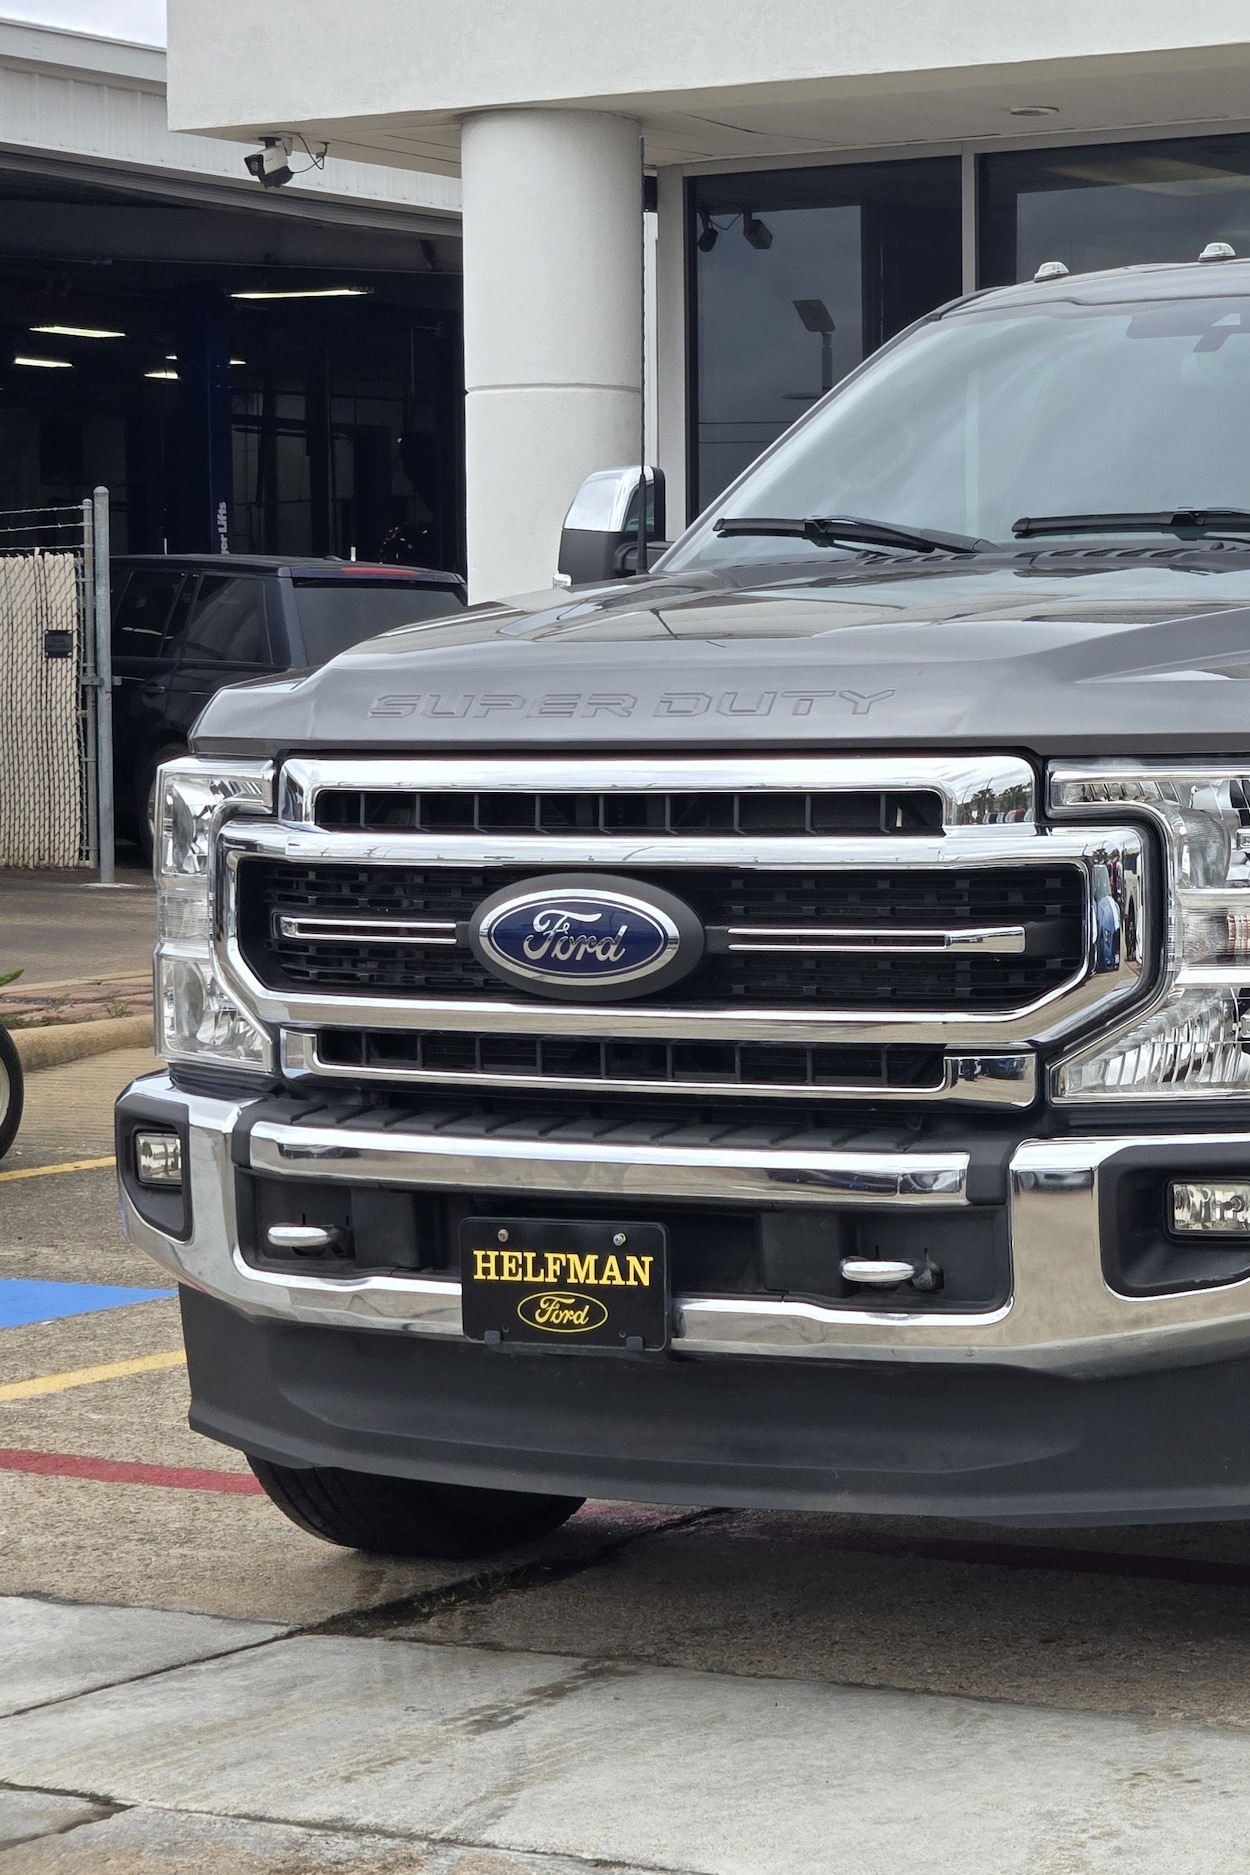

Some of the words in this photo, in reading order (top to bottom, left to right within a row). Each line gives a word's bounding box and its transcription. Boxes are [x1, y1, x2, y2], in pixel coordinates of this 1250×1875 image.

[217, 501, 228, 533] Lifts
[367, 692, 639, 720] SUPER
[652, 688, 896, 719] DUTY
[522, 908, 629, 962] Ford
[472, 1249, 654, 1287] HELFMAN
[534, 1295, 590, 1326] Ford
